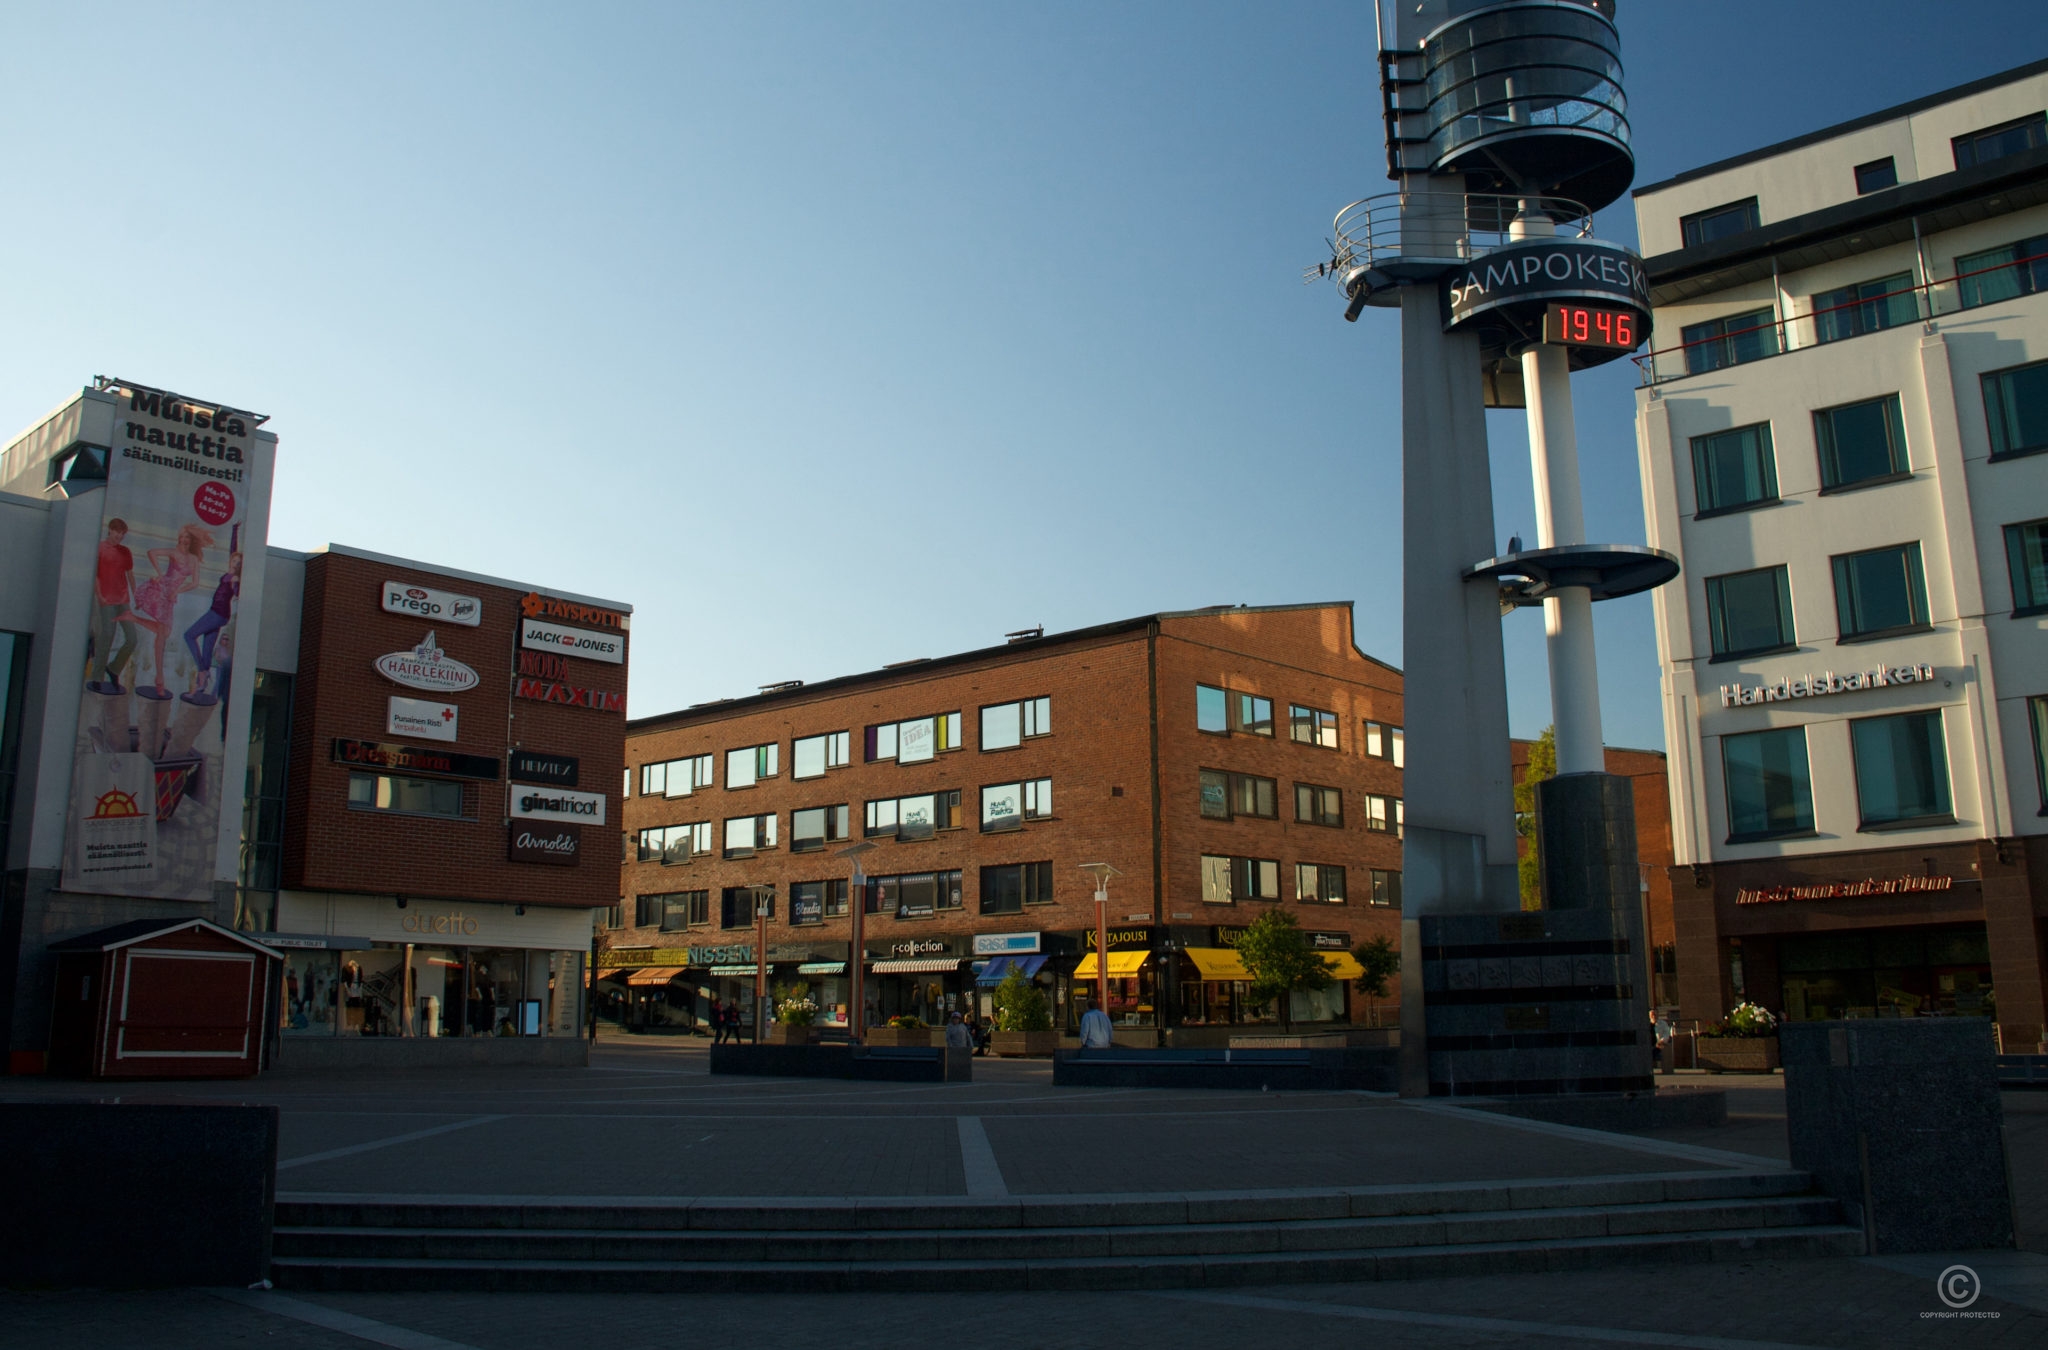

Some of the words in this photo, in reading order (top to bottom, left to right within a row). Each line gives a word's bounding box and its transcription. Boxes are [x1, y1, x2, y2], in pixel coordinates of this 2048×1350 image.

[1560, 308, 1632, 346] 1946
[129, 388, 247, 438] Muista
[126, 421, 244, 465] nauttia
[122, 446, 243, 483] säännöllisesti!
[390, 592, 441, 615] Prego
[545, 598, 622, 628] TÄYSPOTTI
[526, 629, 562, 645] JACK
[574, 637, 616, 653] JONES
[388, 660, 469, 684] HAIRLEKIINI
[518, 650, 570, 682] MODA
[516, 678, 626, 713] MAXIM
[1719, 662, 1935, 708] Handelsbanken
[394, 713, 426, 725] Punainen
[516, 832, 576, 852] Arnolds
[401, 910, 480, 936] duetto
[891, 940, 944, 957] r-collection
[1086, 930, 1148, 948] KTAJOUSI
[687, 945, 751, 964] NISSEN
